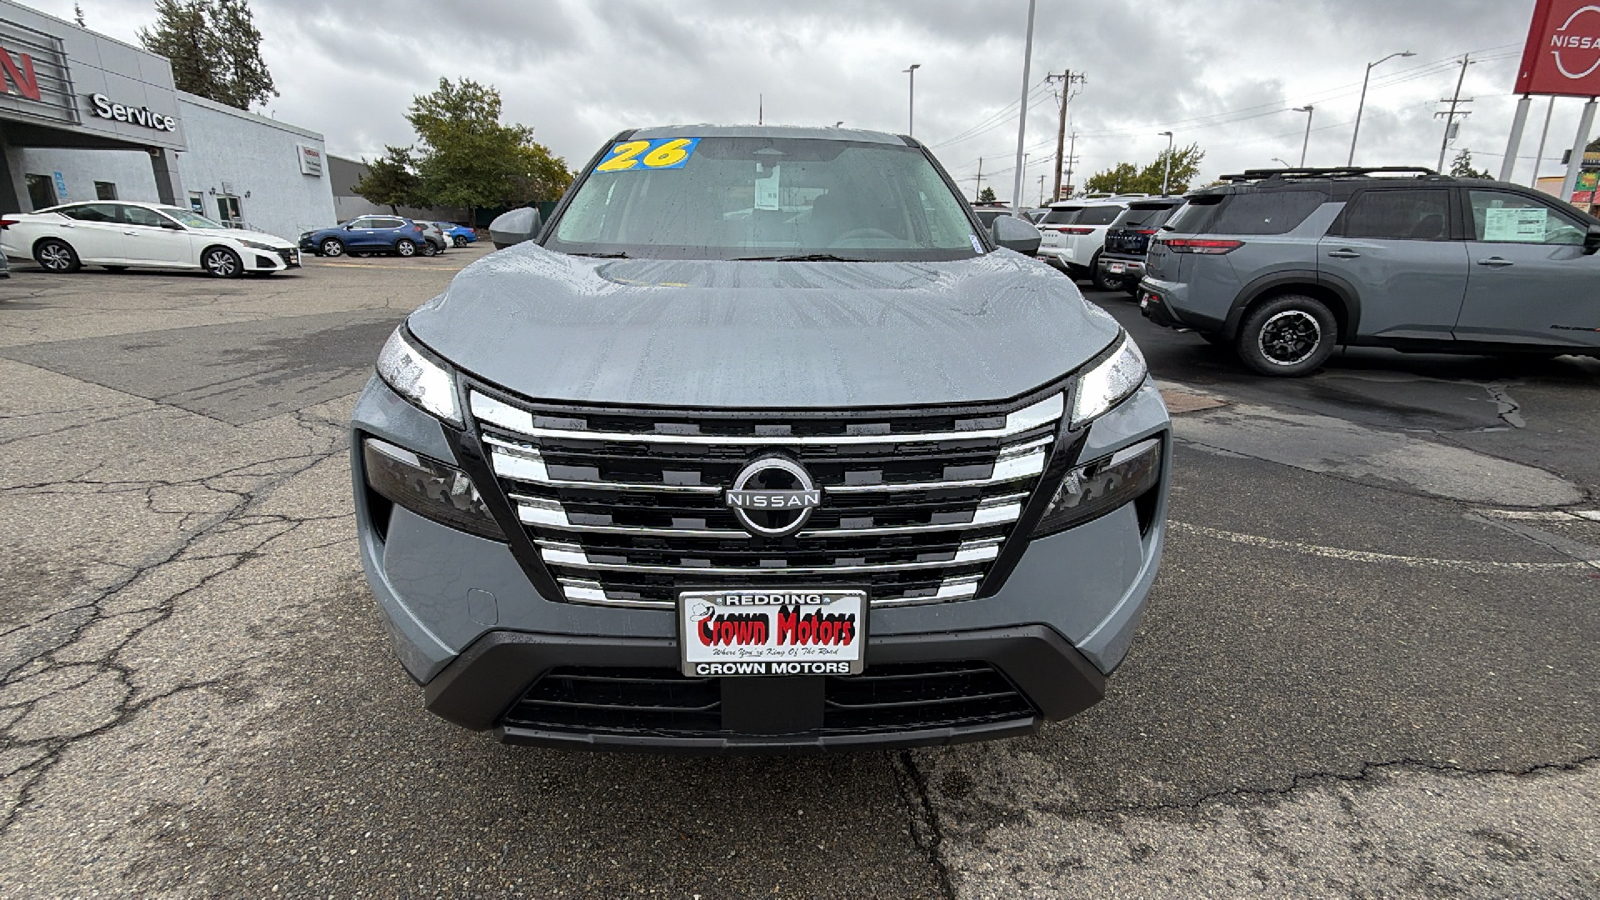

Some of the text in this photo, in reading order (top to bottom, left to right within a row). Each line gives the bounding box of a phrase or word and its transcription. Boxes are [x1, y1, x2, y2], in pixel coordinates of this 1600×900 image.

[91, 93, 176, 133] Service
[596, 138, 693, 172] 26
[727, 493, 819, 508] NISSAN
[726, 594, 821, 606] REDDING
[697, 607, 855, 647] Crown Motors
[712, 648, 736, 656] Where
[766, 647, 786, 658] King
[788, 647, 799, 657] Of
[801, 648, 816, 656] The
[818, 647, 840, 656] Road
[696, 662, 850, 675] CROWN MOTORS
